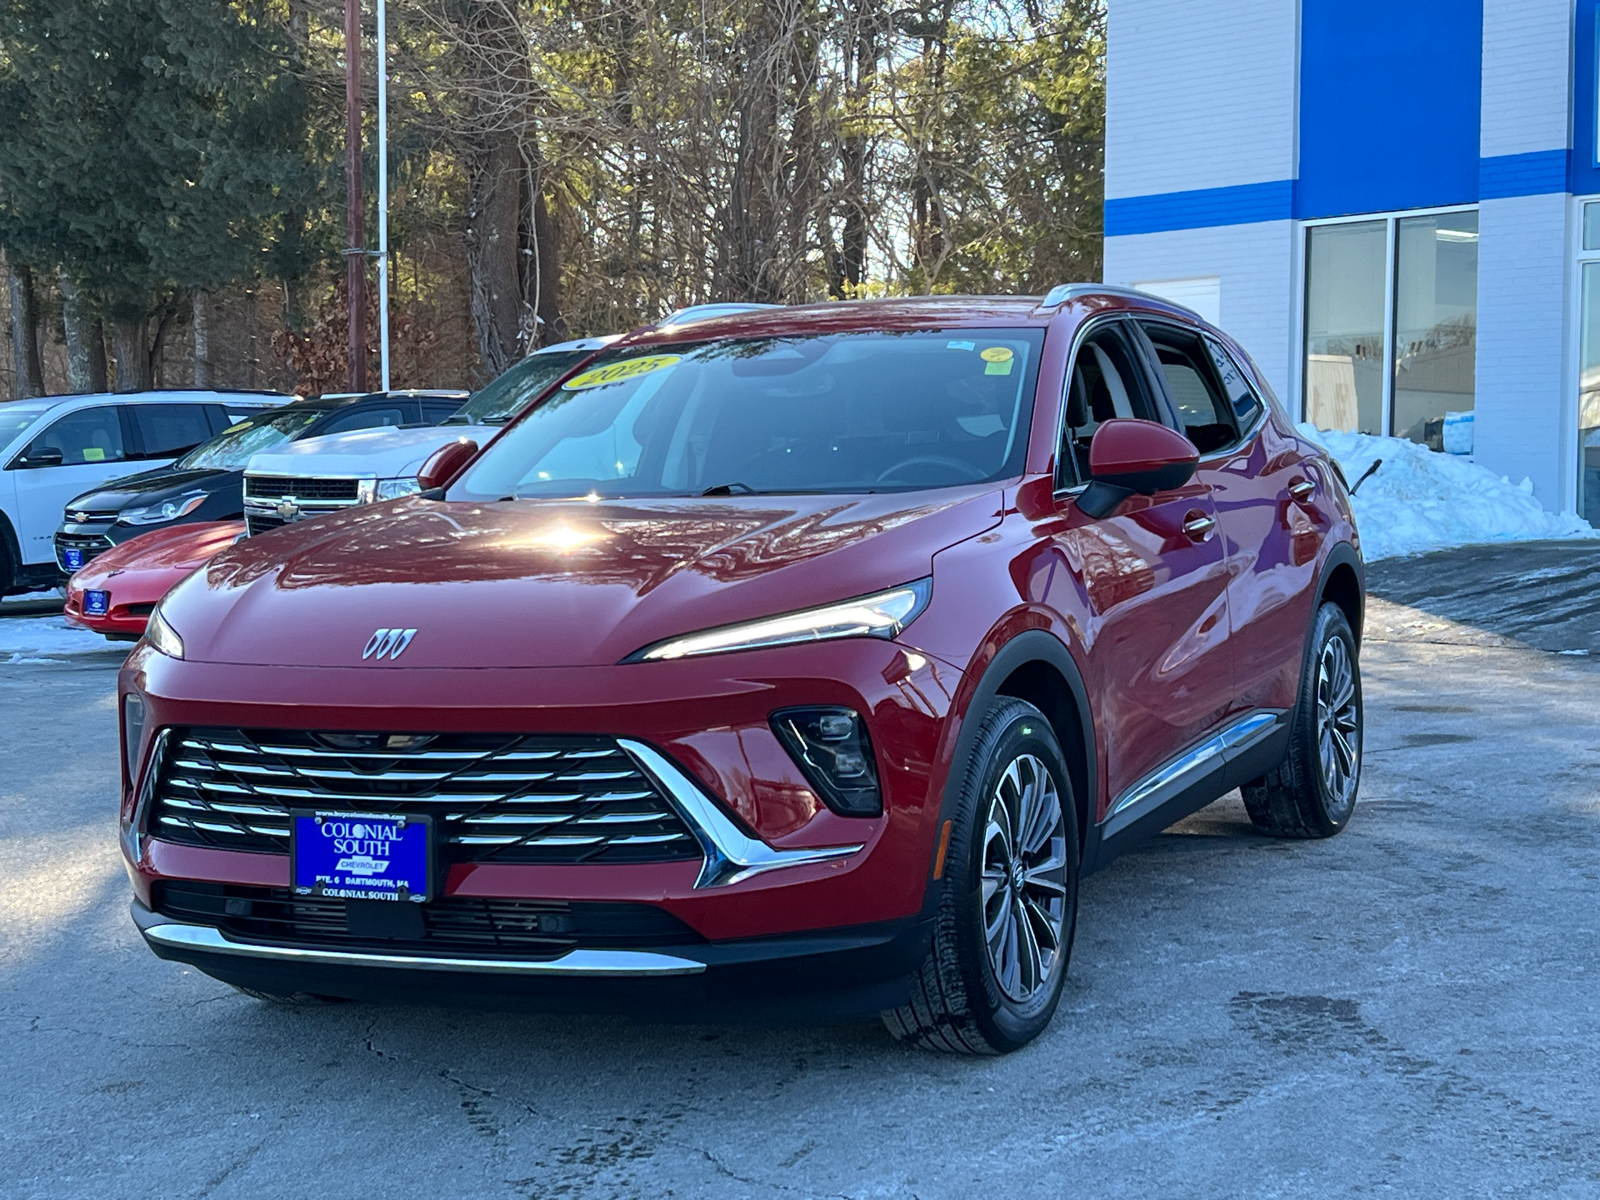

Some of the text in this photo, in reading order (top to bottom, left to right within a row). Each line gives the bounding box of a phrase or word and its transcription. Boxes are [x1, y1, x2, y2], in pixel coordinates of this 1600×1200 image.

[578, 357, 669, 386] 2025
[321, 822, 403, 841] COLONIAL
[334, 839, 390, 856] SOUTH
[341, 860, 384, 869] CHEVROLET
[334, 876, 340, 884] 6
[345, 877, 396, 888] DARTMOUTH,
[322, 888, 399, 901] COLONIAL SOUTH
